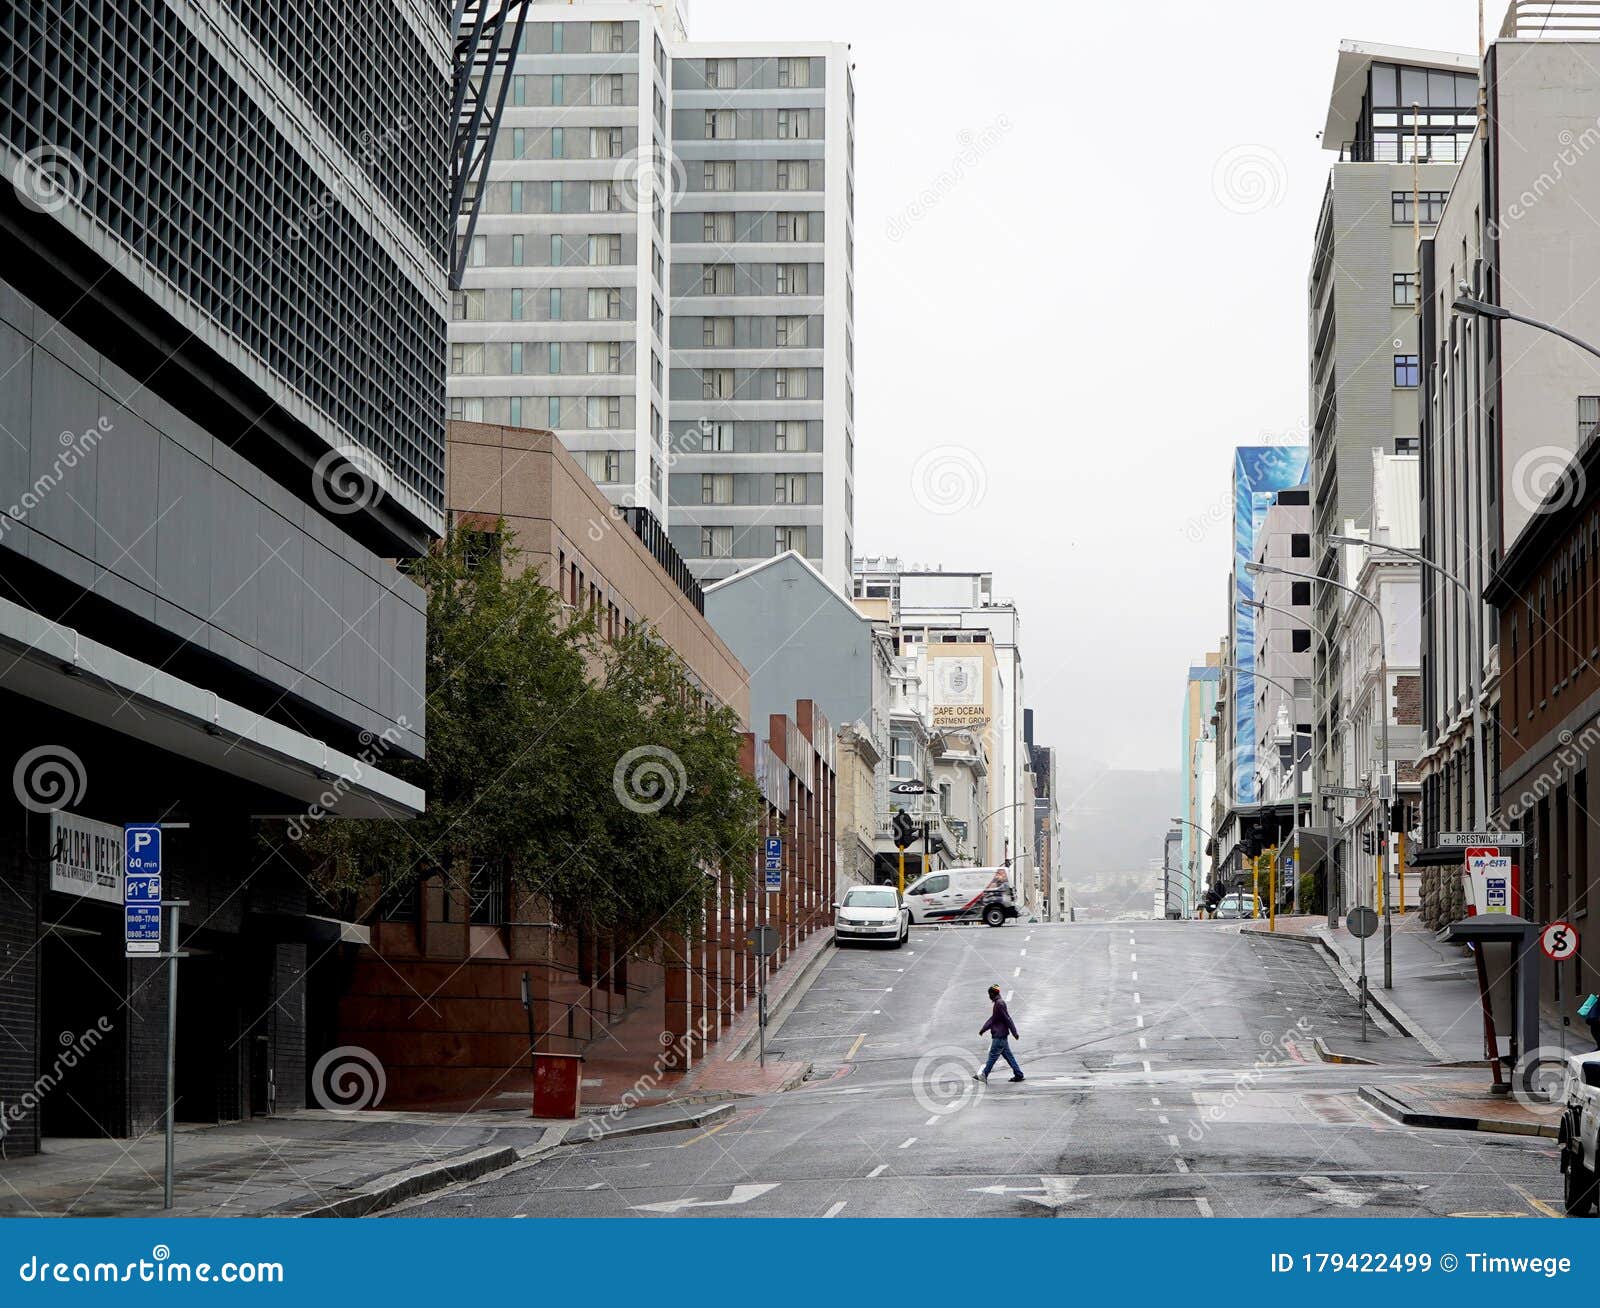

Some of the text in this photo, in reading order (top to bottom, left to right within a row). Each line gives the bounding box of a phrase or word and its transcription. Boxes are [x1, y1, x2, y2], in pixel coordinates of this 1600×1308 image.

[933, 707, 985, 715] CAPE OCEAN
[135, 832, 152, 853] P
[1456, 834, 1498, 844] PRESTWICH
[770, 840, 778, 849] P
[95, 835, 120, 879] DELTA
[129, 858, 142, 868] 60
